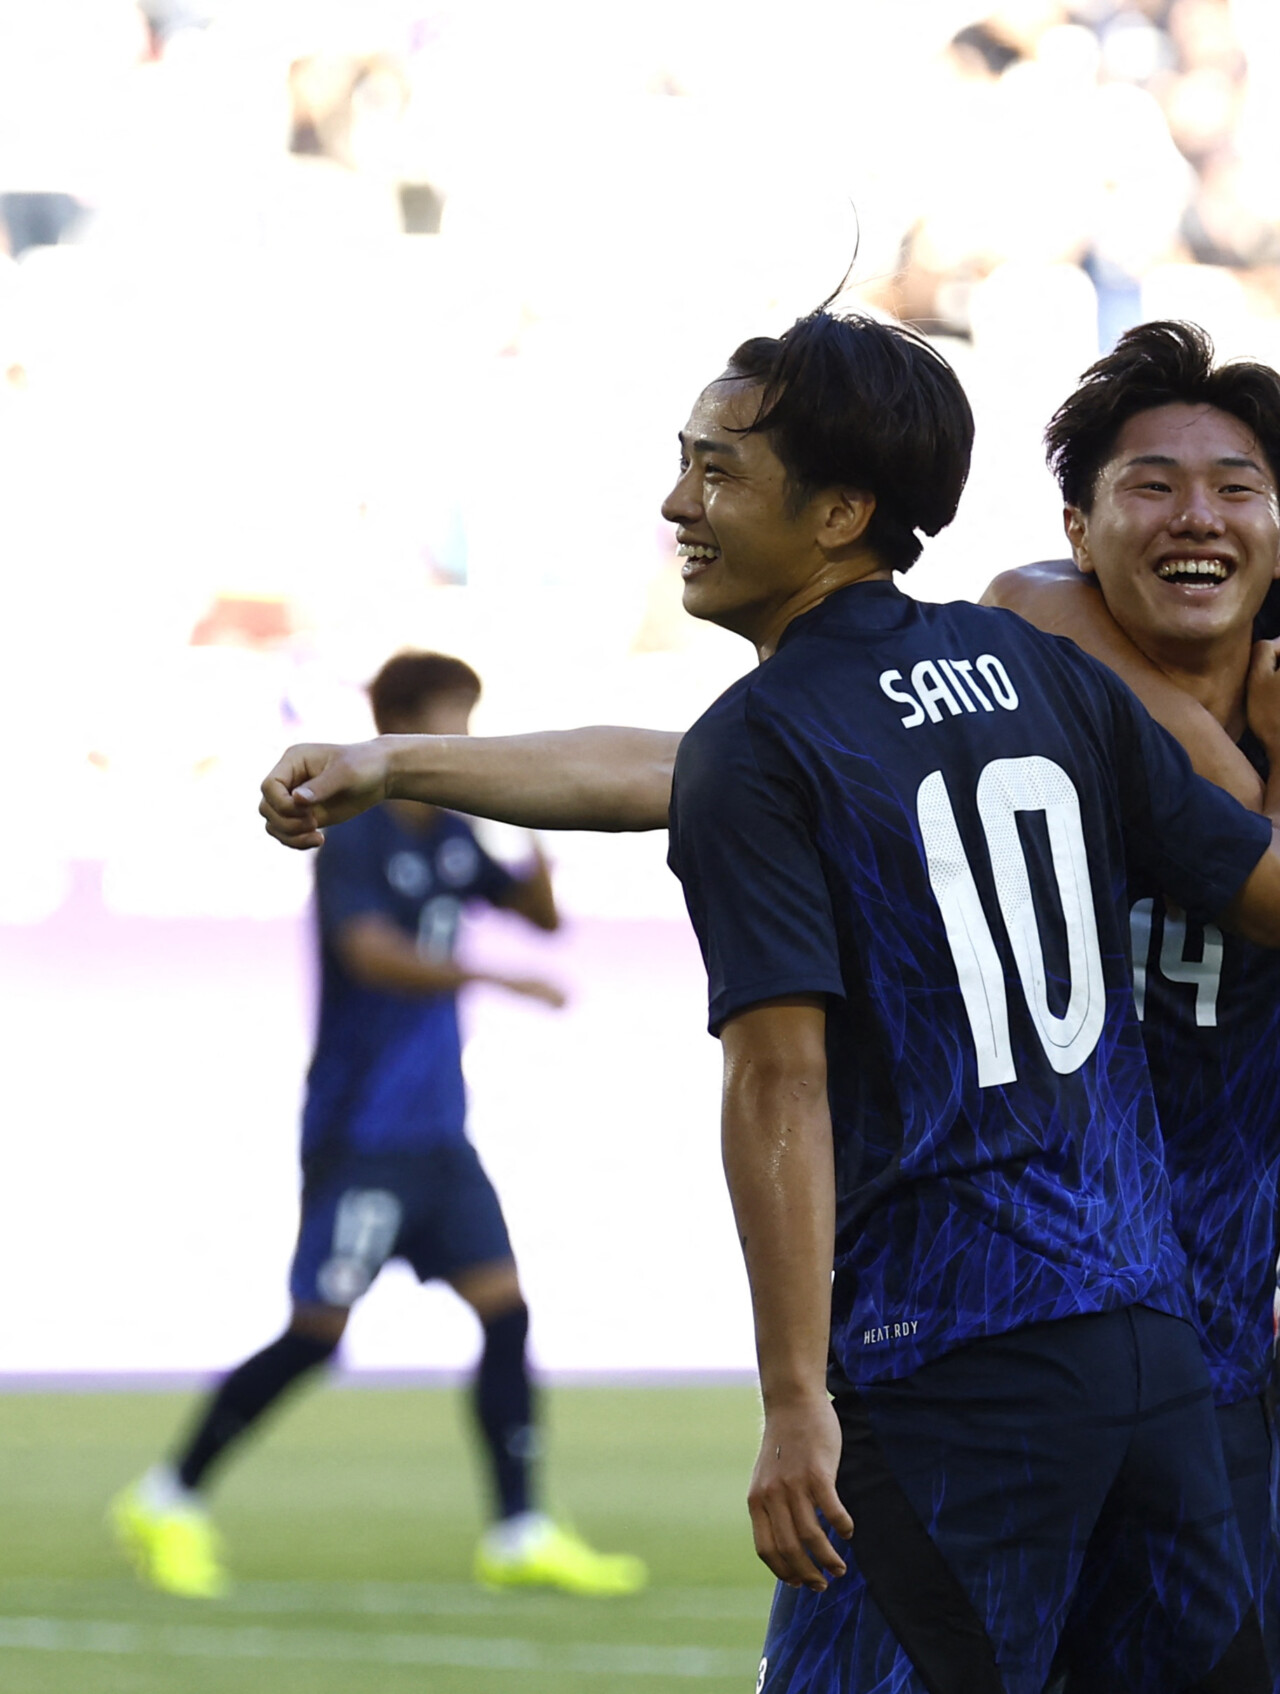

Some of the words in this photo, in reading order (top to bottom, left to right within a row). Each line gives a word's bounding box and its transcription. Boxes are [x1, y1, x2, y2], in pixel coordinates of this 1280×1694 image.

[879, 653, 1019, 729] SAITO
[916, 755, 1106, 1089] 10
[1129, 897, 1224, 1027] 14
[863, 1320, 918, 1345] HEAT.RDY
